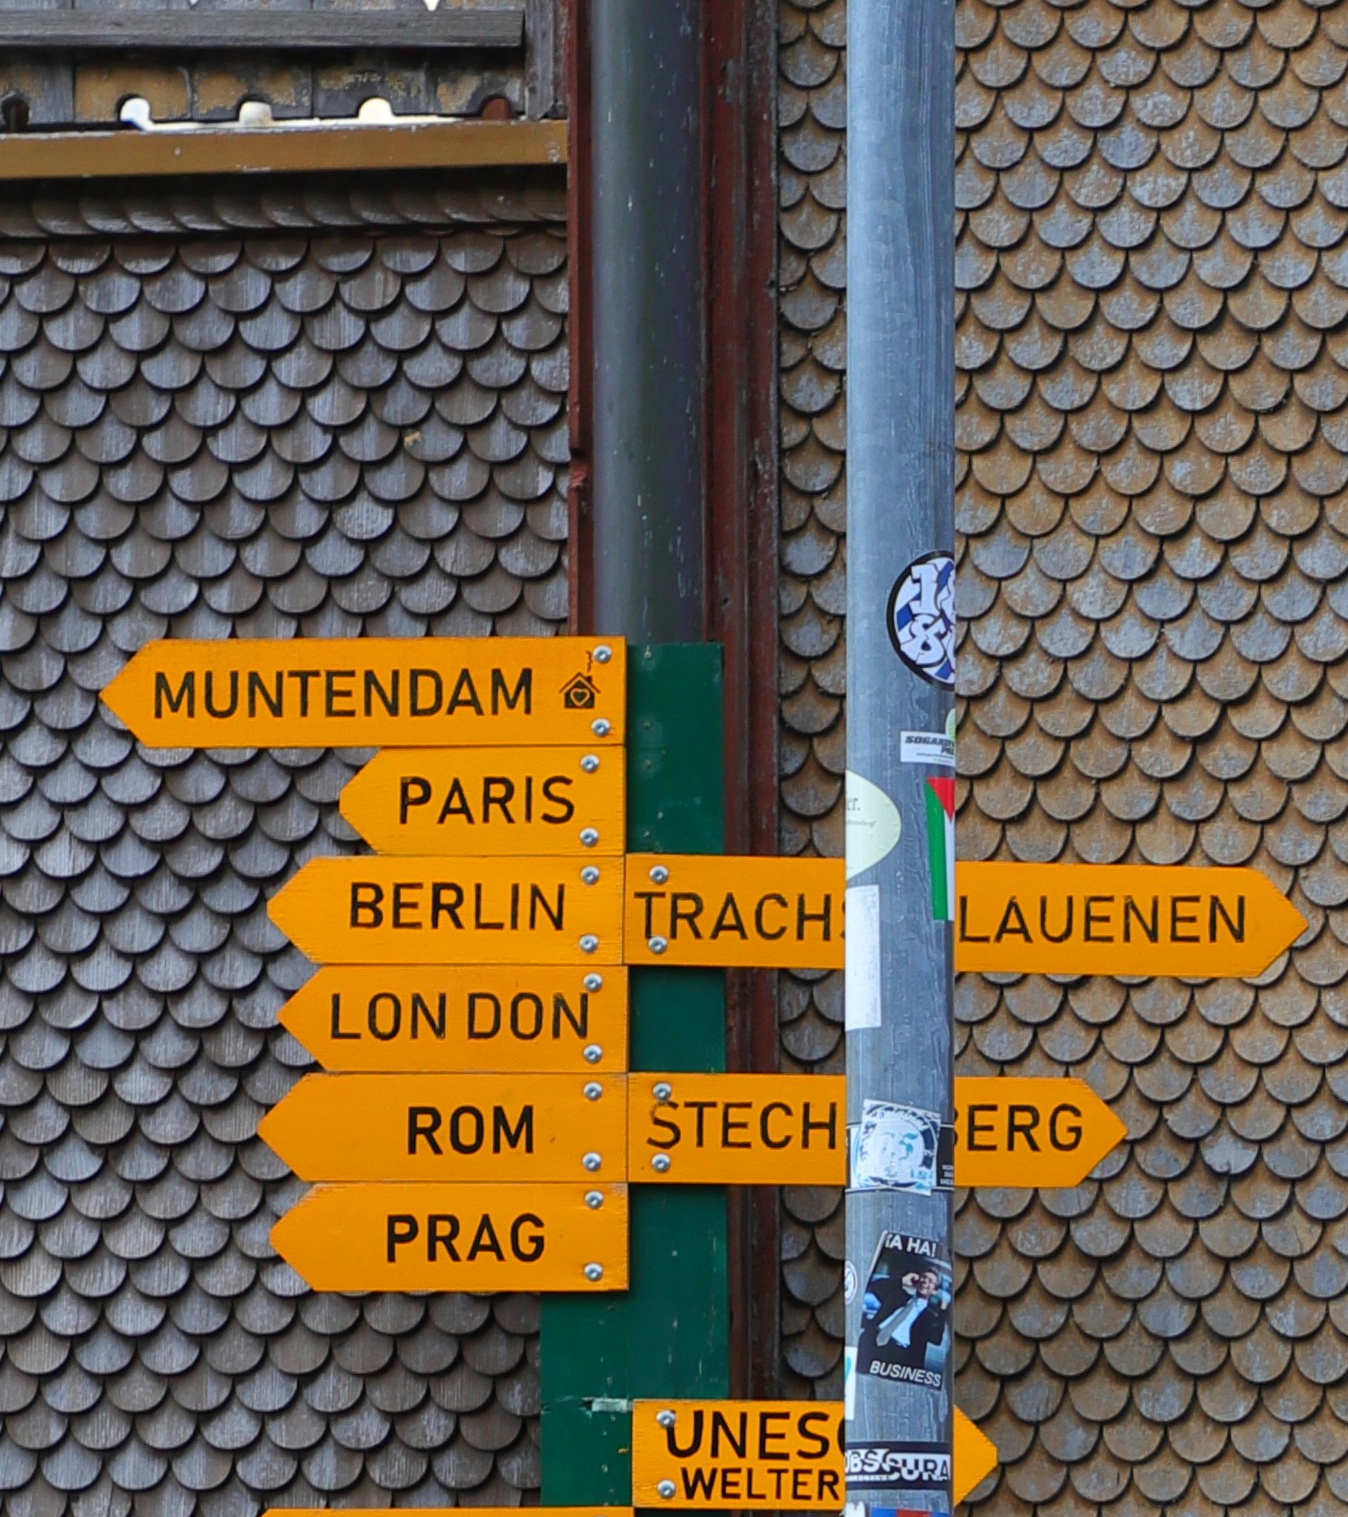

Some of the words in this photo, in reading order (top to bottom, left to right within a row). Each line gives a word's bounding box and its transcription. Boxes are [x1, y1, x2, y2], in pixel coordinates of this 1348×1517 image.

[154, 668, 533, 719] MUNTENDAM
[399, 776, 575, 825] PARIS
[349, 882, 565, 931] BERLIN
[330, 992, 590, 1041] LONDON
[407, 1104, 534, 1155] ROM
[385, 1213, 545, 1263] PRAG
[870, 1360, 942, 1388] BUSINESS
[666, 1409, 844, 1461] UNES
